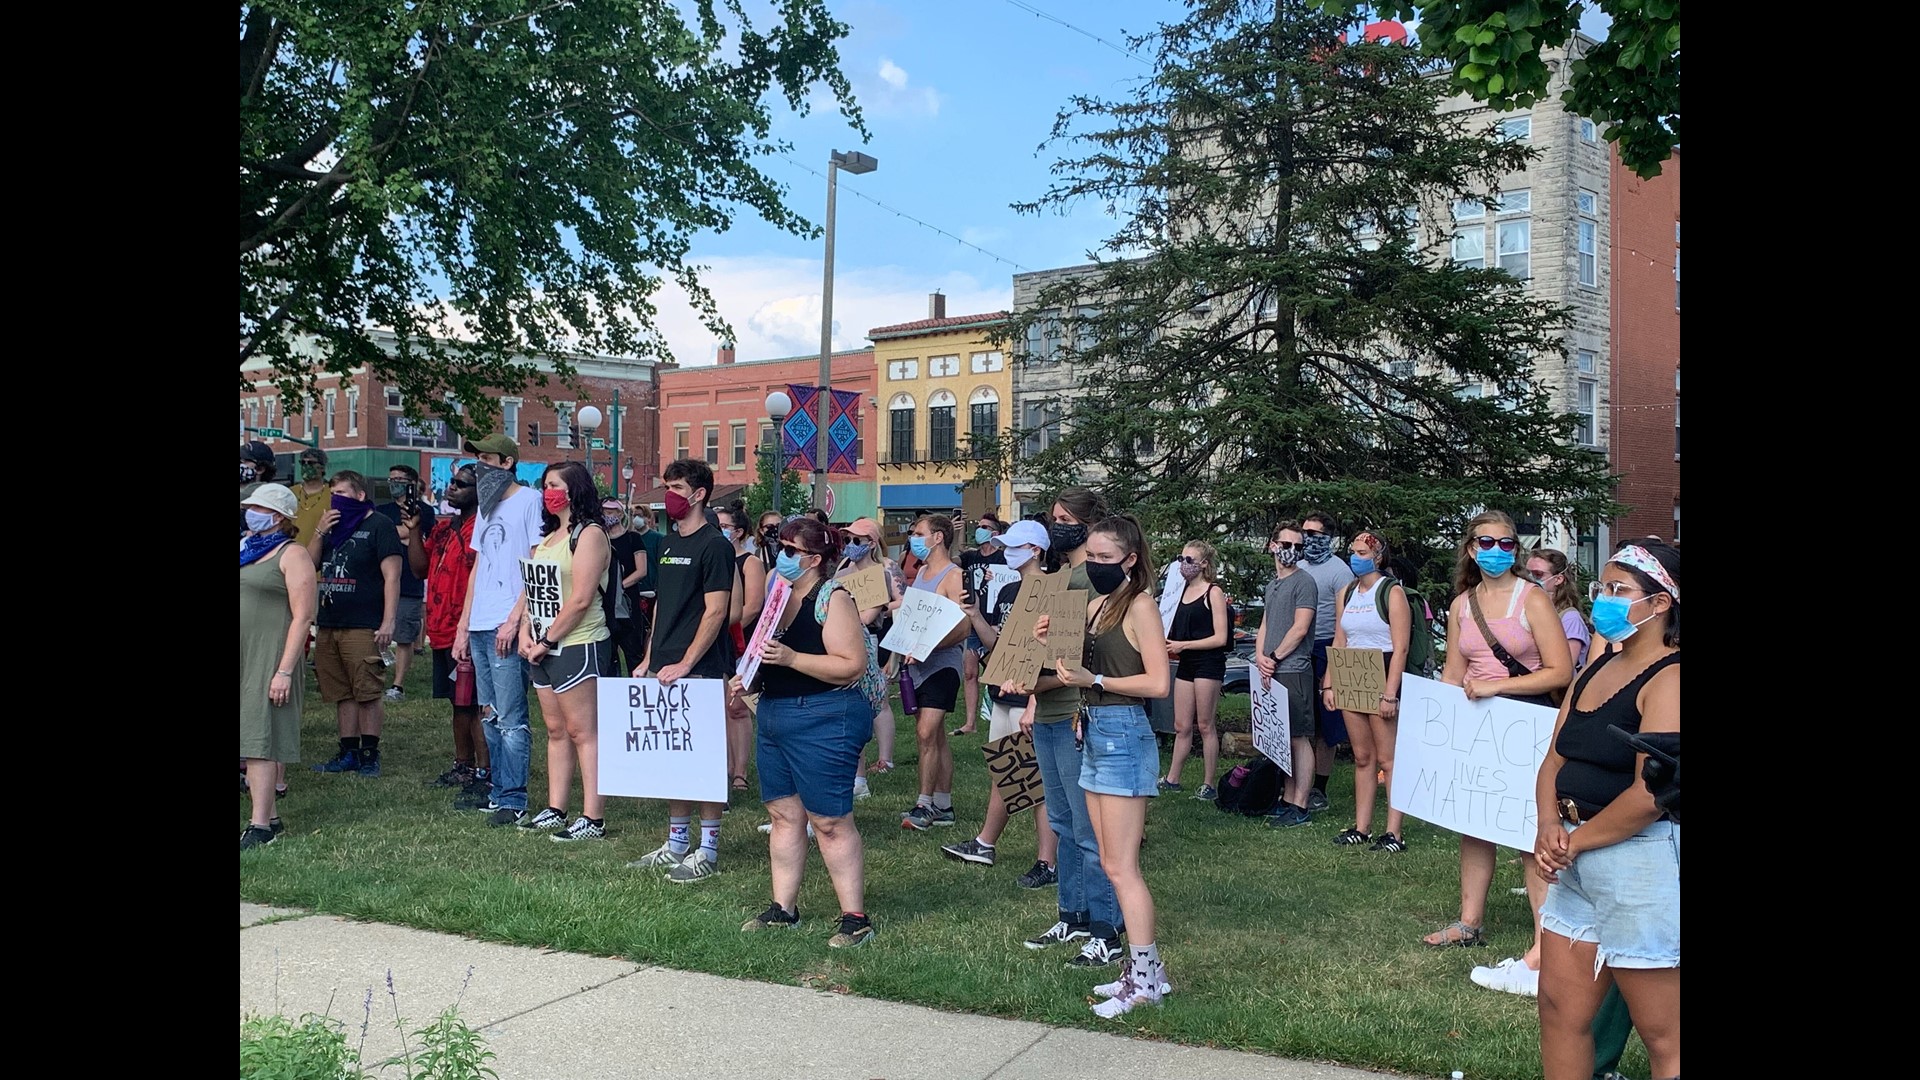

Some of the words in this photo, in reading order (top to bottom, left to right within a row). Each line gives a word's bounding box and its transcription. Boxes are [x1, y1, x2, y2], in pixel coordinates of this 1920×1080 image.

[1332, 648, 1380, 671] BLACK
[1338, 669, 1378, 690] LIVES
[628, 684, 690, 708] BLACK
[1336, 690, 1379, 710] MATTE
[630, 708, 690, 732] LIVES
[1252, 690, 1264, 750] STOP
[626, 730, 693, 752] MATTER
[1420, 697, 1552, 774] BLACK
[981, 736, 1034, 814] BLACK
[1454, 758, 1508, 792] LIVES
[1408, 768, 1538, 836] MATTER
